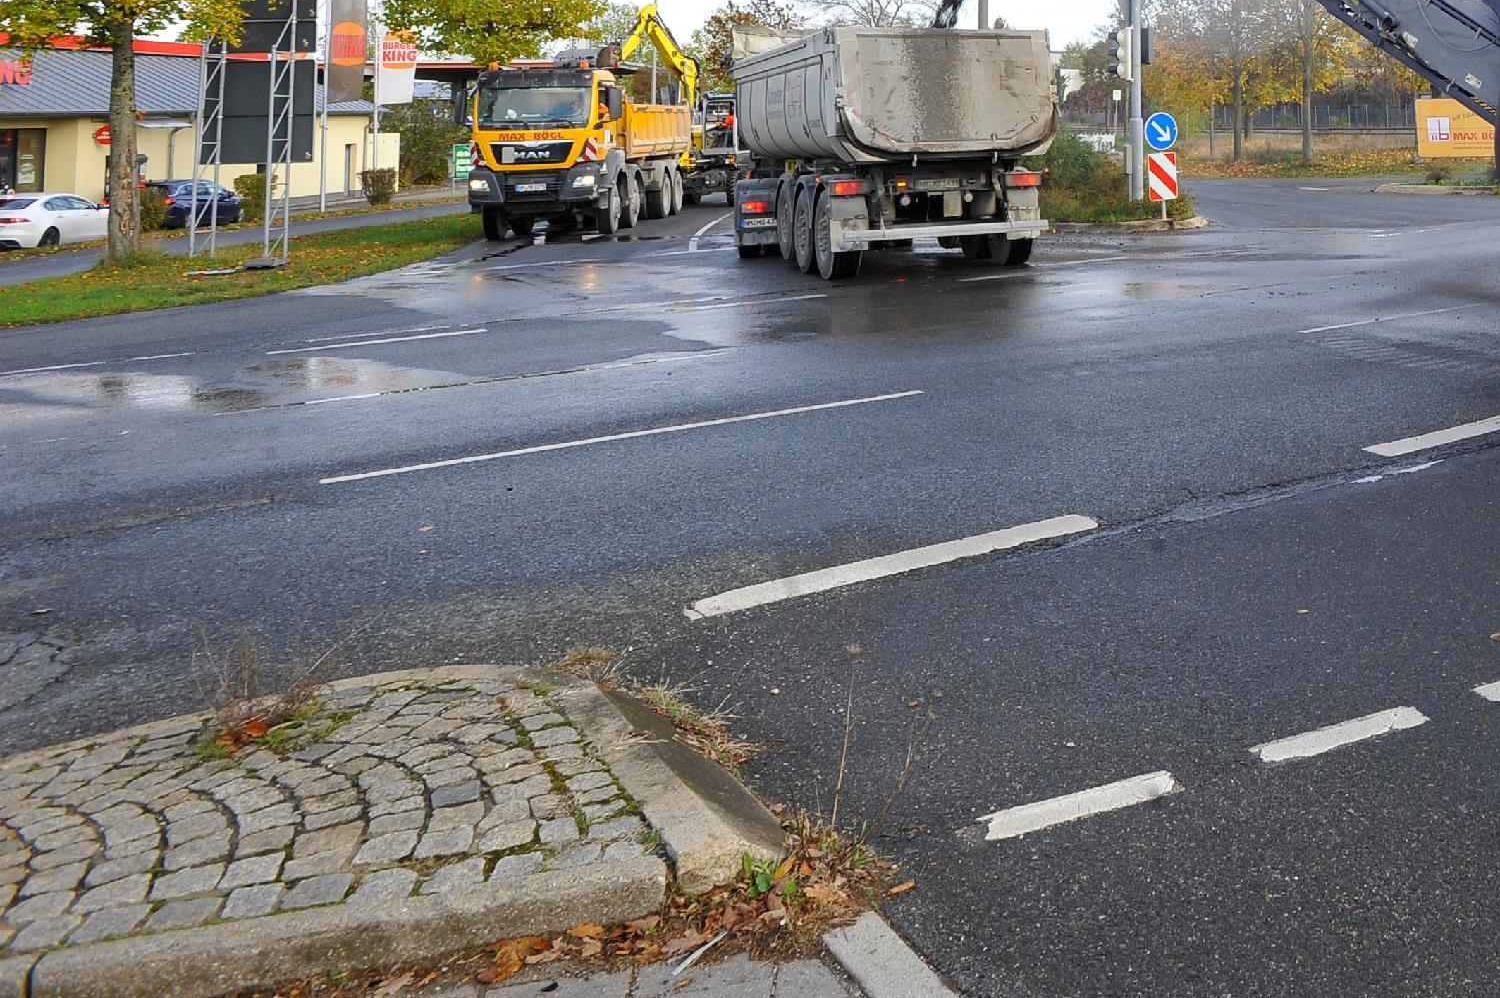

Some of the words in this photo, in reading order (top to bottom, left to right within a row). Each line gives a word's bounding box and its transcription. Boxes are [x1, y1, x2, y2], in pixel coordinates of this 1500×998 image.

[383, 50, 417, 62] KING
[0, 58, 32, 86] NG
[498, 132, 526, 141] MAX
[533, 130, 565, 140] BÖGL
[1453, 132, 1478, 141] MAX
[1481, 129, 1495, 140] BÖ
[514, 151, 551, 159] MAN
